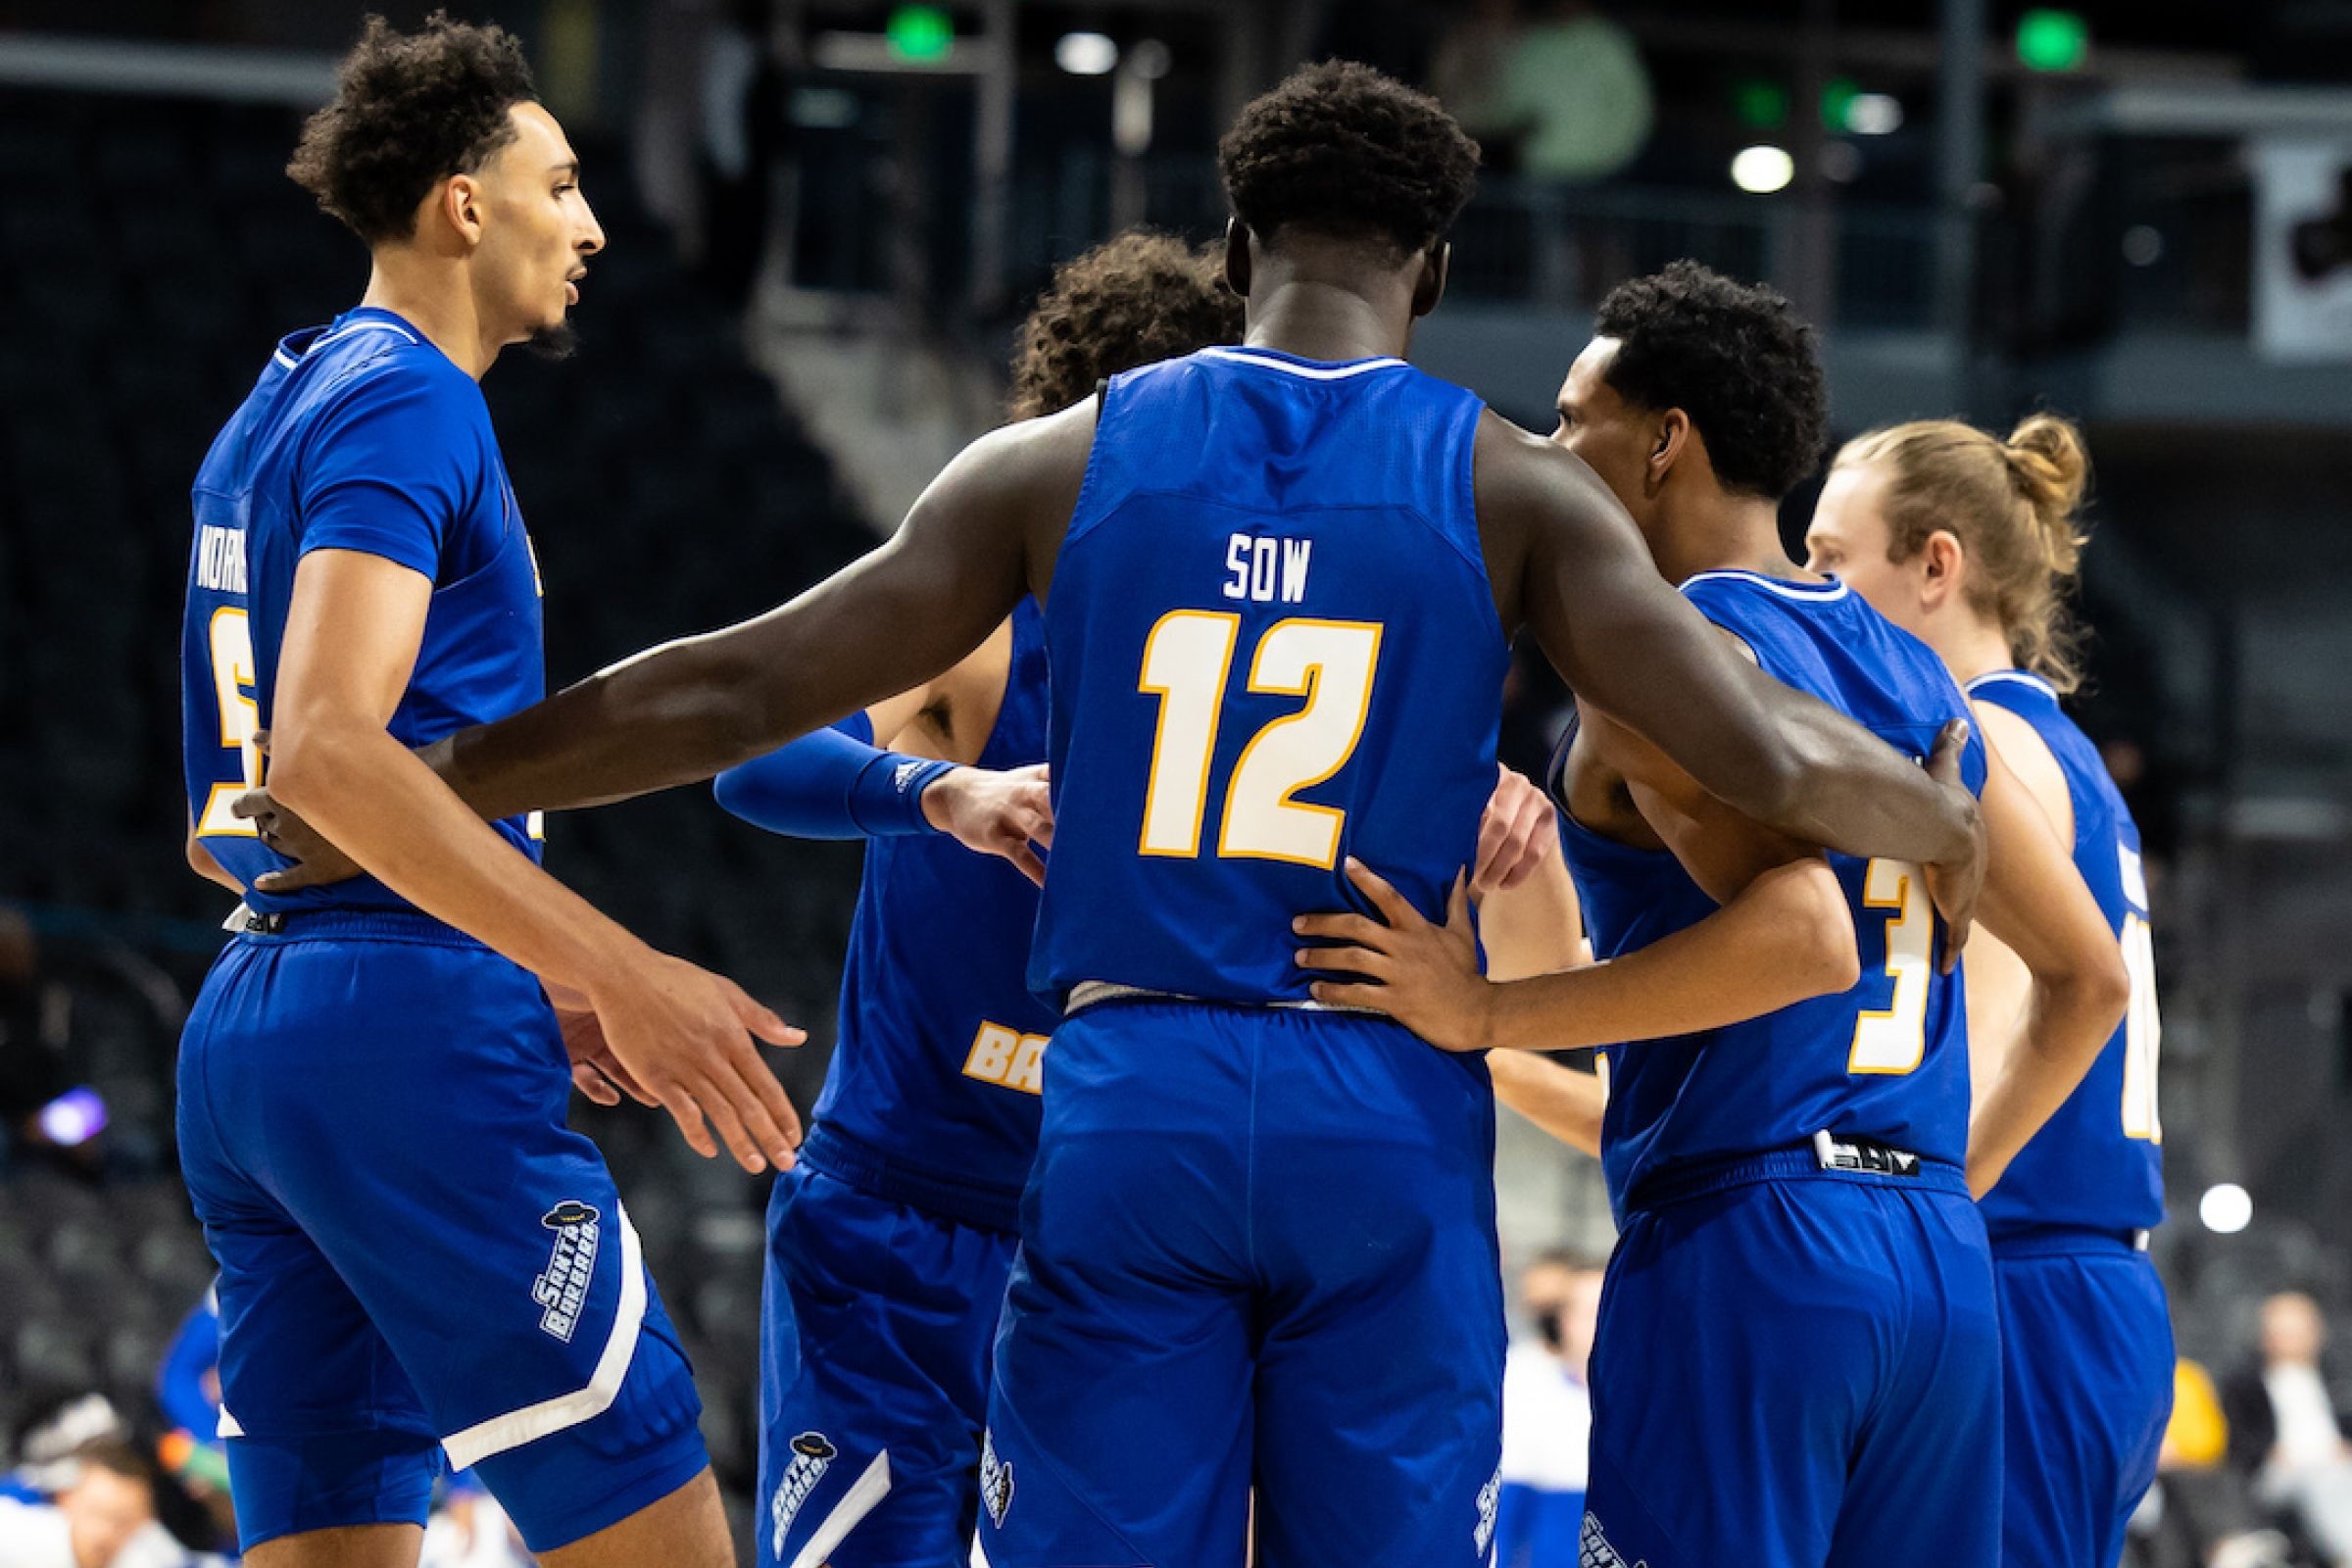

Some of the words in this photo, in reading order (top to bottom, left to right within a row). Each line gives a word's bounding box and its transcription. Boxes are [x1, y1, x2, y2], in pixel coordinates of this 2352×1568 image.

[1222, 533, 1313, 604] SOW
[196, 606, 263, 838] 5
[1137, 609, 1384, 871] 12
[1846, 857, 1935, 1075] 3
[961, 1019, 1052, 1096] BA
[533, 1223, 580, 1310] SANTA
